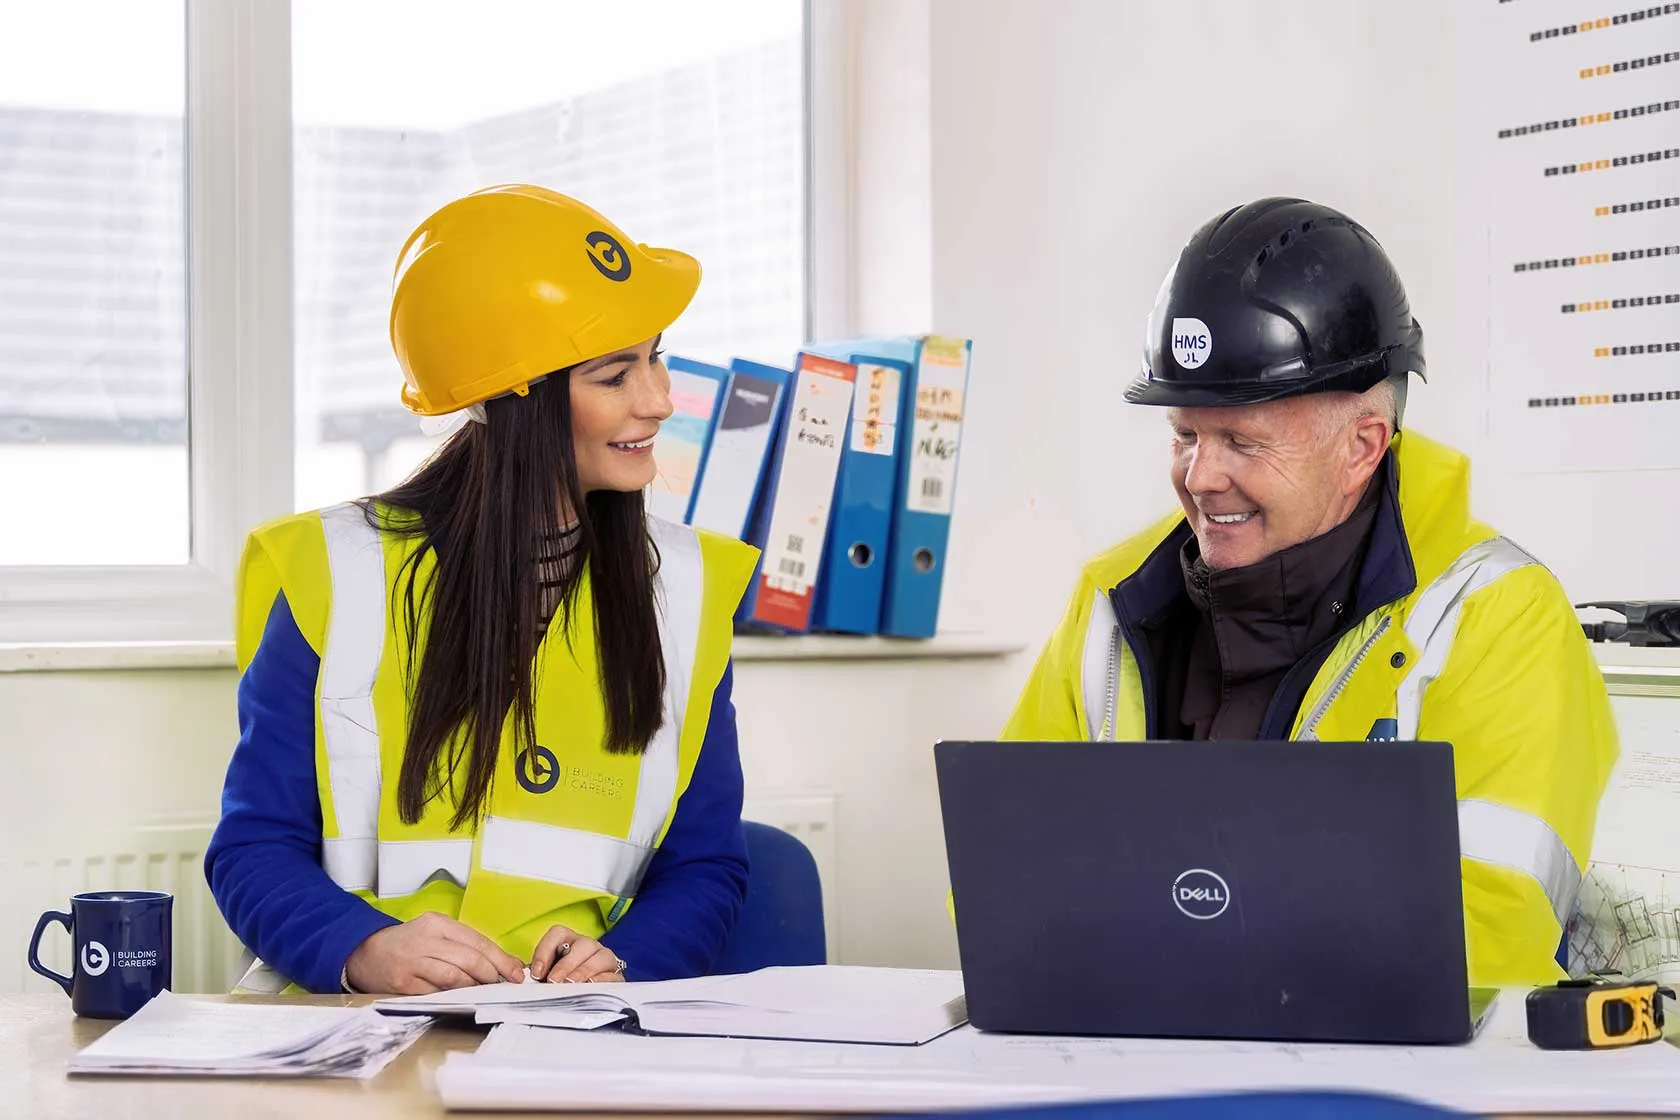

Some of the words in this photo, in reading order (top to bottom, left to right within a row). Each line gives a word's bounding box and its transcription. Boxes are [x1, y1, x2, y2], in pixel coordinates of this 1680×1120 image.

[1175, 335, 1206, 349] HMS
[572, 767, 624, 788] BUILDING
[570, 779, 623, 800] CAREERS
[1180, 887, 1224, 901] DELL
[118, 951, 157, 959] BUILDING
[118, 959, 157, 967] CAREERS
